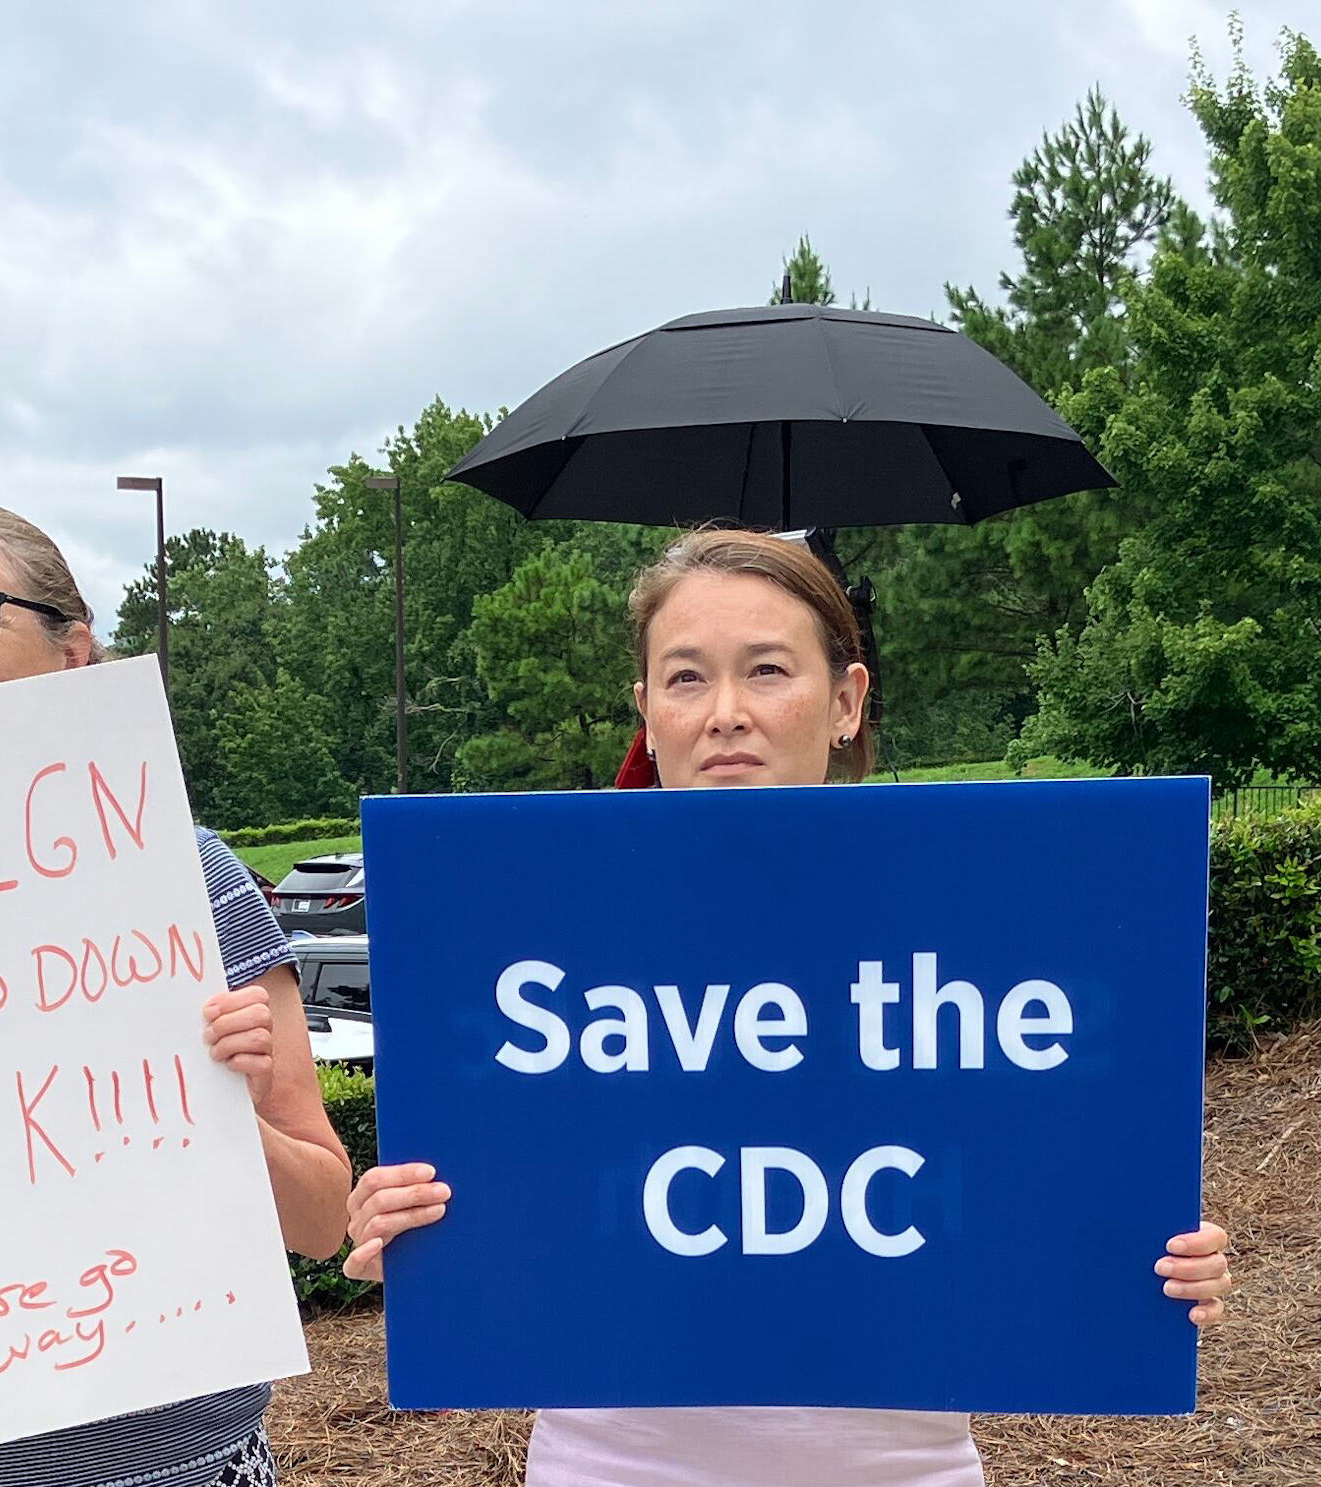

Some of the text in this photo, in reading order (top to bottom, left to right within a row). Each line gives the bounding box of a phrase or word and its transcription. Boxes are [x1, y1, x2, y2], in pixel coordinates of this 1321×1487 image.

[32, 925, 205, 1013] DOWN
[496, 953, 1072, 1073] Save the
[644, 1146, 925, 1256] CDC
[68, 1249, 137, 1318] go
